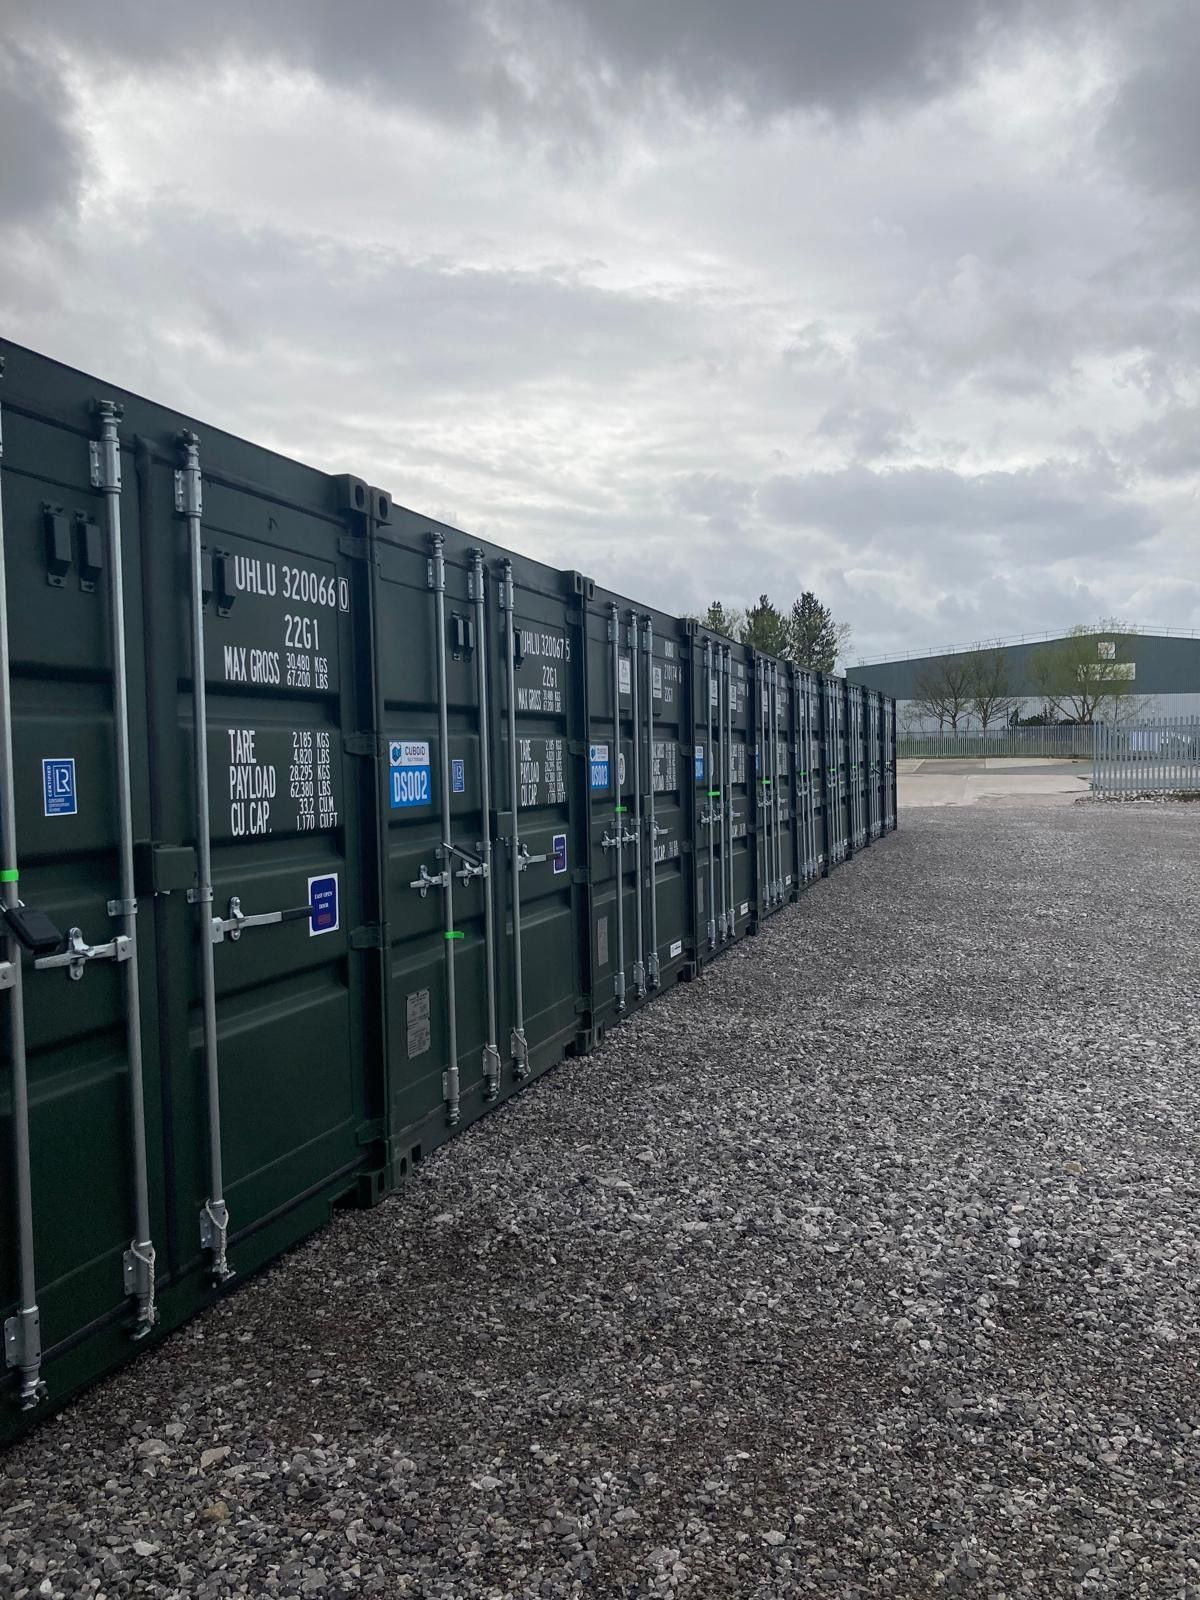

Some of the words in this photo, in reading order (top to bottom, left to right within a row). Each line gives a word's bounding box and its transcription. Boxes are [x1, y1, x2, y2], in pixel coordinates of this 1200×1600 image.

[234, 555, 277, 597] UHLU
[281, 566, 336, 607] 320066
[284, 614, 319, 650] 22G1
[541, 634, 564, 659] 320067
[223, 645, 248, 682] MAX
[250, 649, 280, 684] GROSS
[286, 652, 310, 671] 30.480
[314, 656, 328, 673] KGS
[286, 670, 311, 687] 67.200
[315, 673, 329, 690] LBS
[542, 665, 557, 688] 22G1
[228, 729, 257, 764] TARE
[292, 731, 312, 748] 2.185
[316, 732, 330, 748] KGS
[404, 746, 426, 756] CUBOID
[293, 748, 313, 764] 4.820
[317, 749, 330, 764] LBS
[56, 768, 70, 792] LR
[229, 765, 276, 800] PAYLOAD
[289, 765, 313, 781] 28.295
[317, 765, 331, 780] KGS
[290, 781, 314, 798] 62.380
[318, 781, 331, 797] LBS
[393, 770, 428, 802] DS002
[299, 797, 315, 814] 33.2
[318, 796, 334, 812] CU.M
[231, 801, 273, 836] CU.CAP.
[296, 814, 315, 832] 1.170
